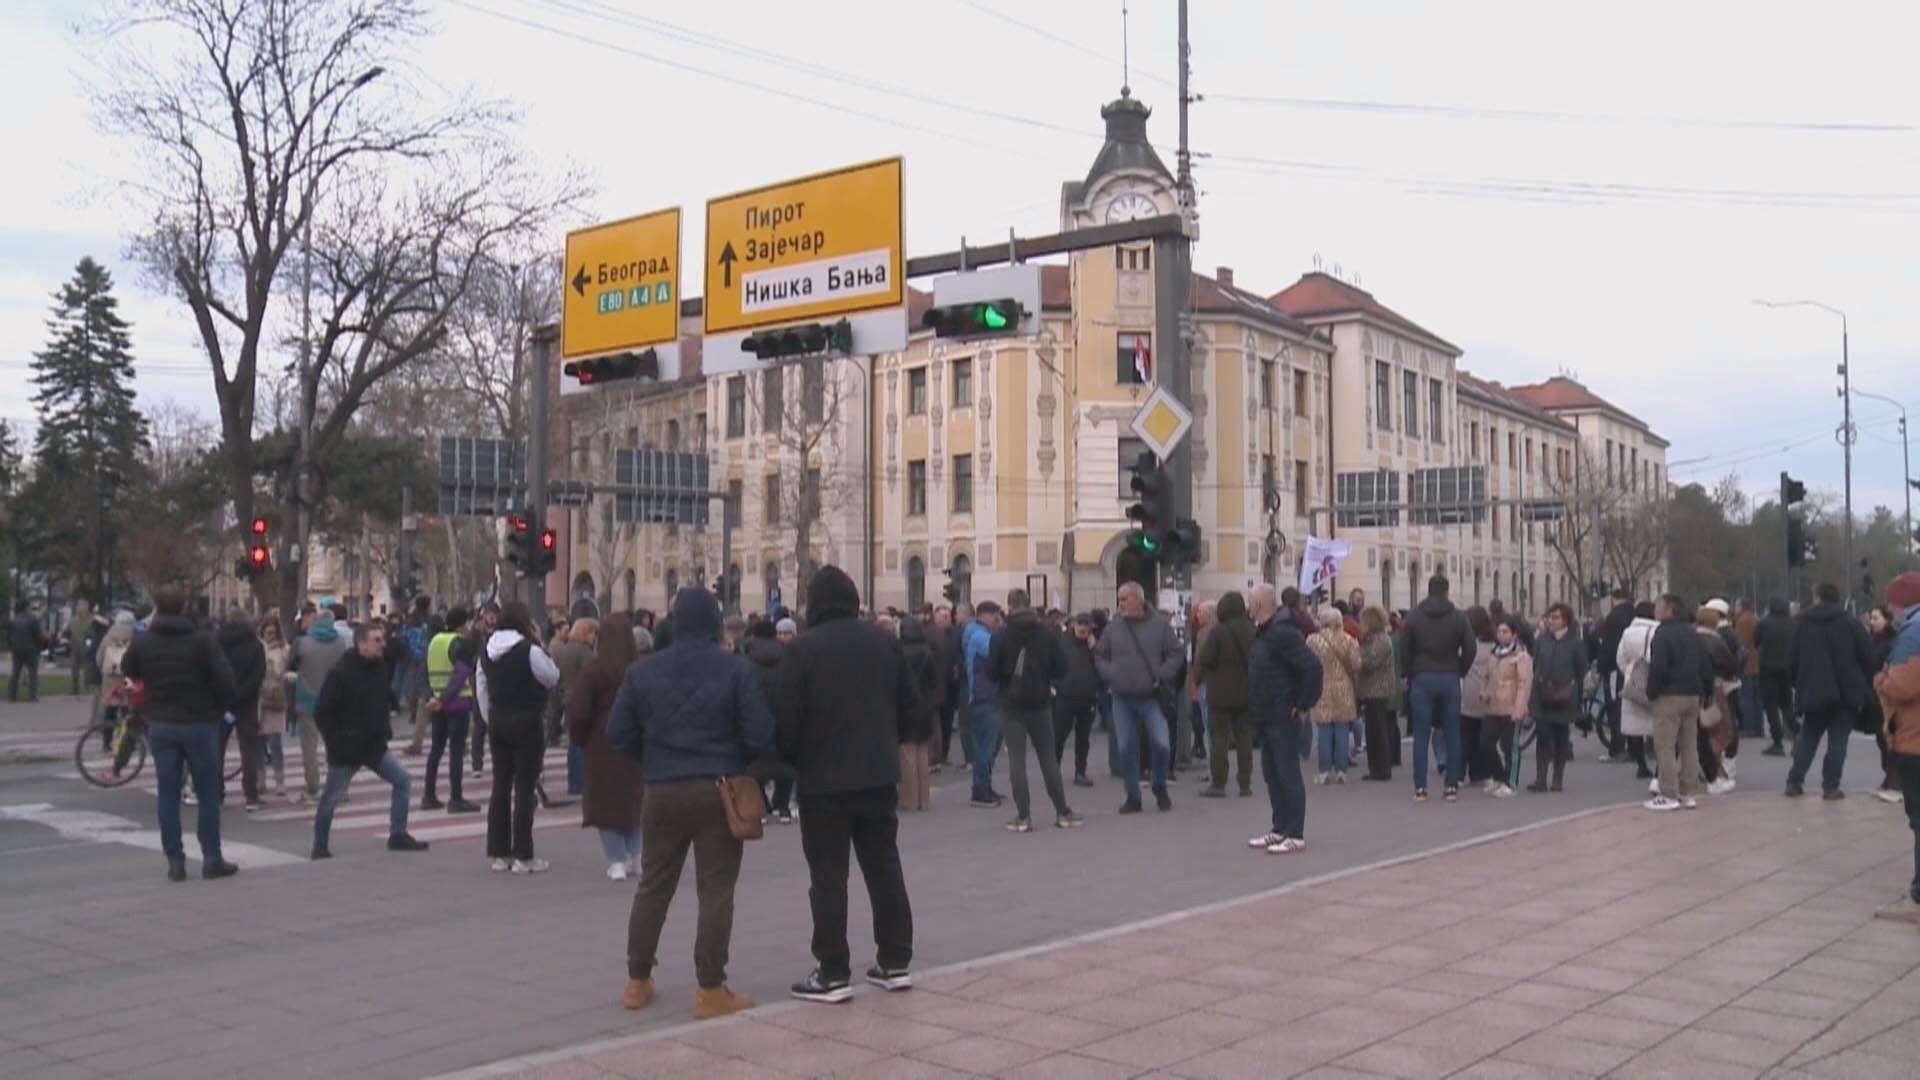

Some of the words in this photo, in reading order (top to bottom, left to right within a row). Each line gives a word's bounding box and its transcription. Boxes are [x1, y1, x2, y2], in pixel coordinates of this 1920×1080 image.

[745, 202, 805, 231] Пирот
[745, 230, 825, 264] Зајечар
[598, 256, 669, 285] Београд
[745, 277, 812, 305] Нишка
[828, 264, 886, 292] Бања
